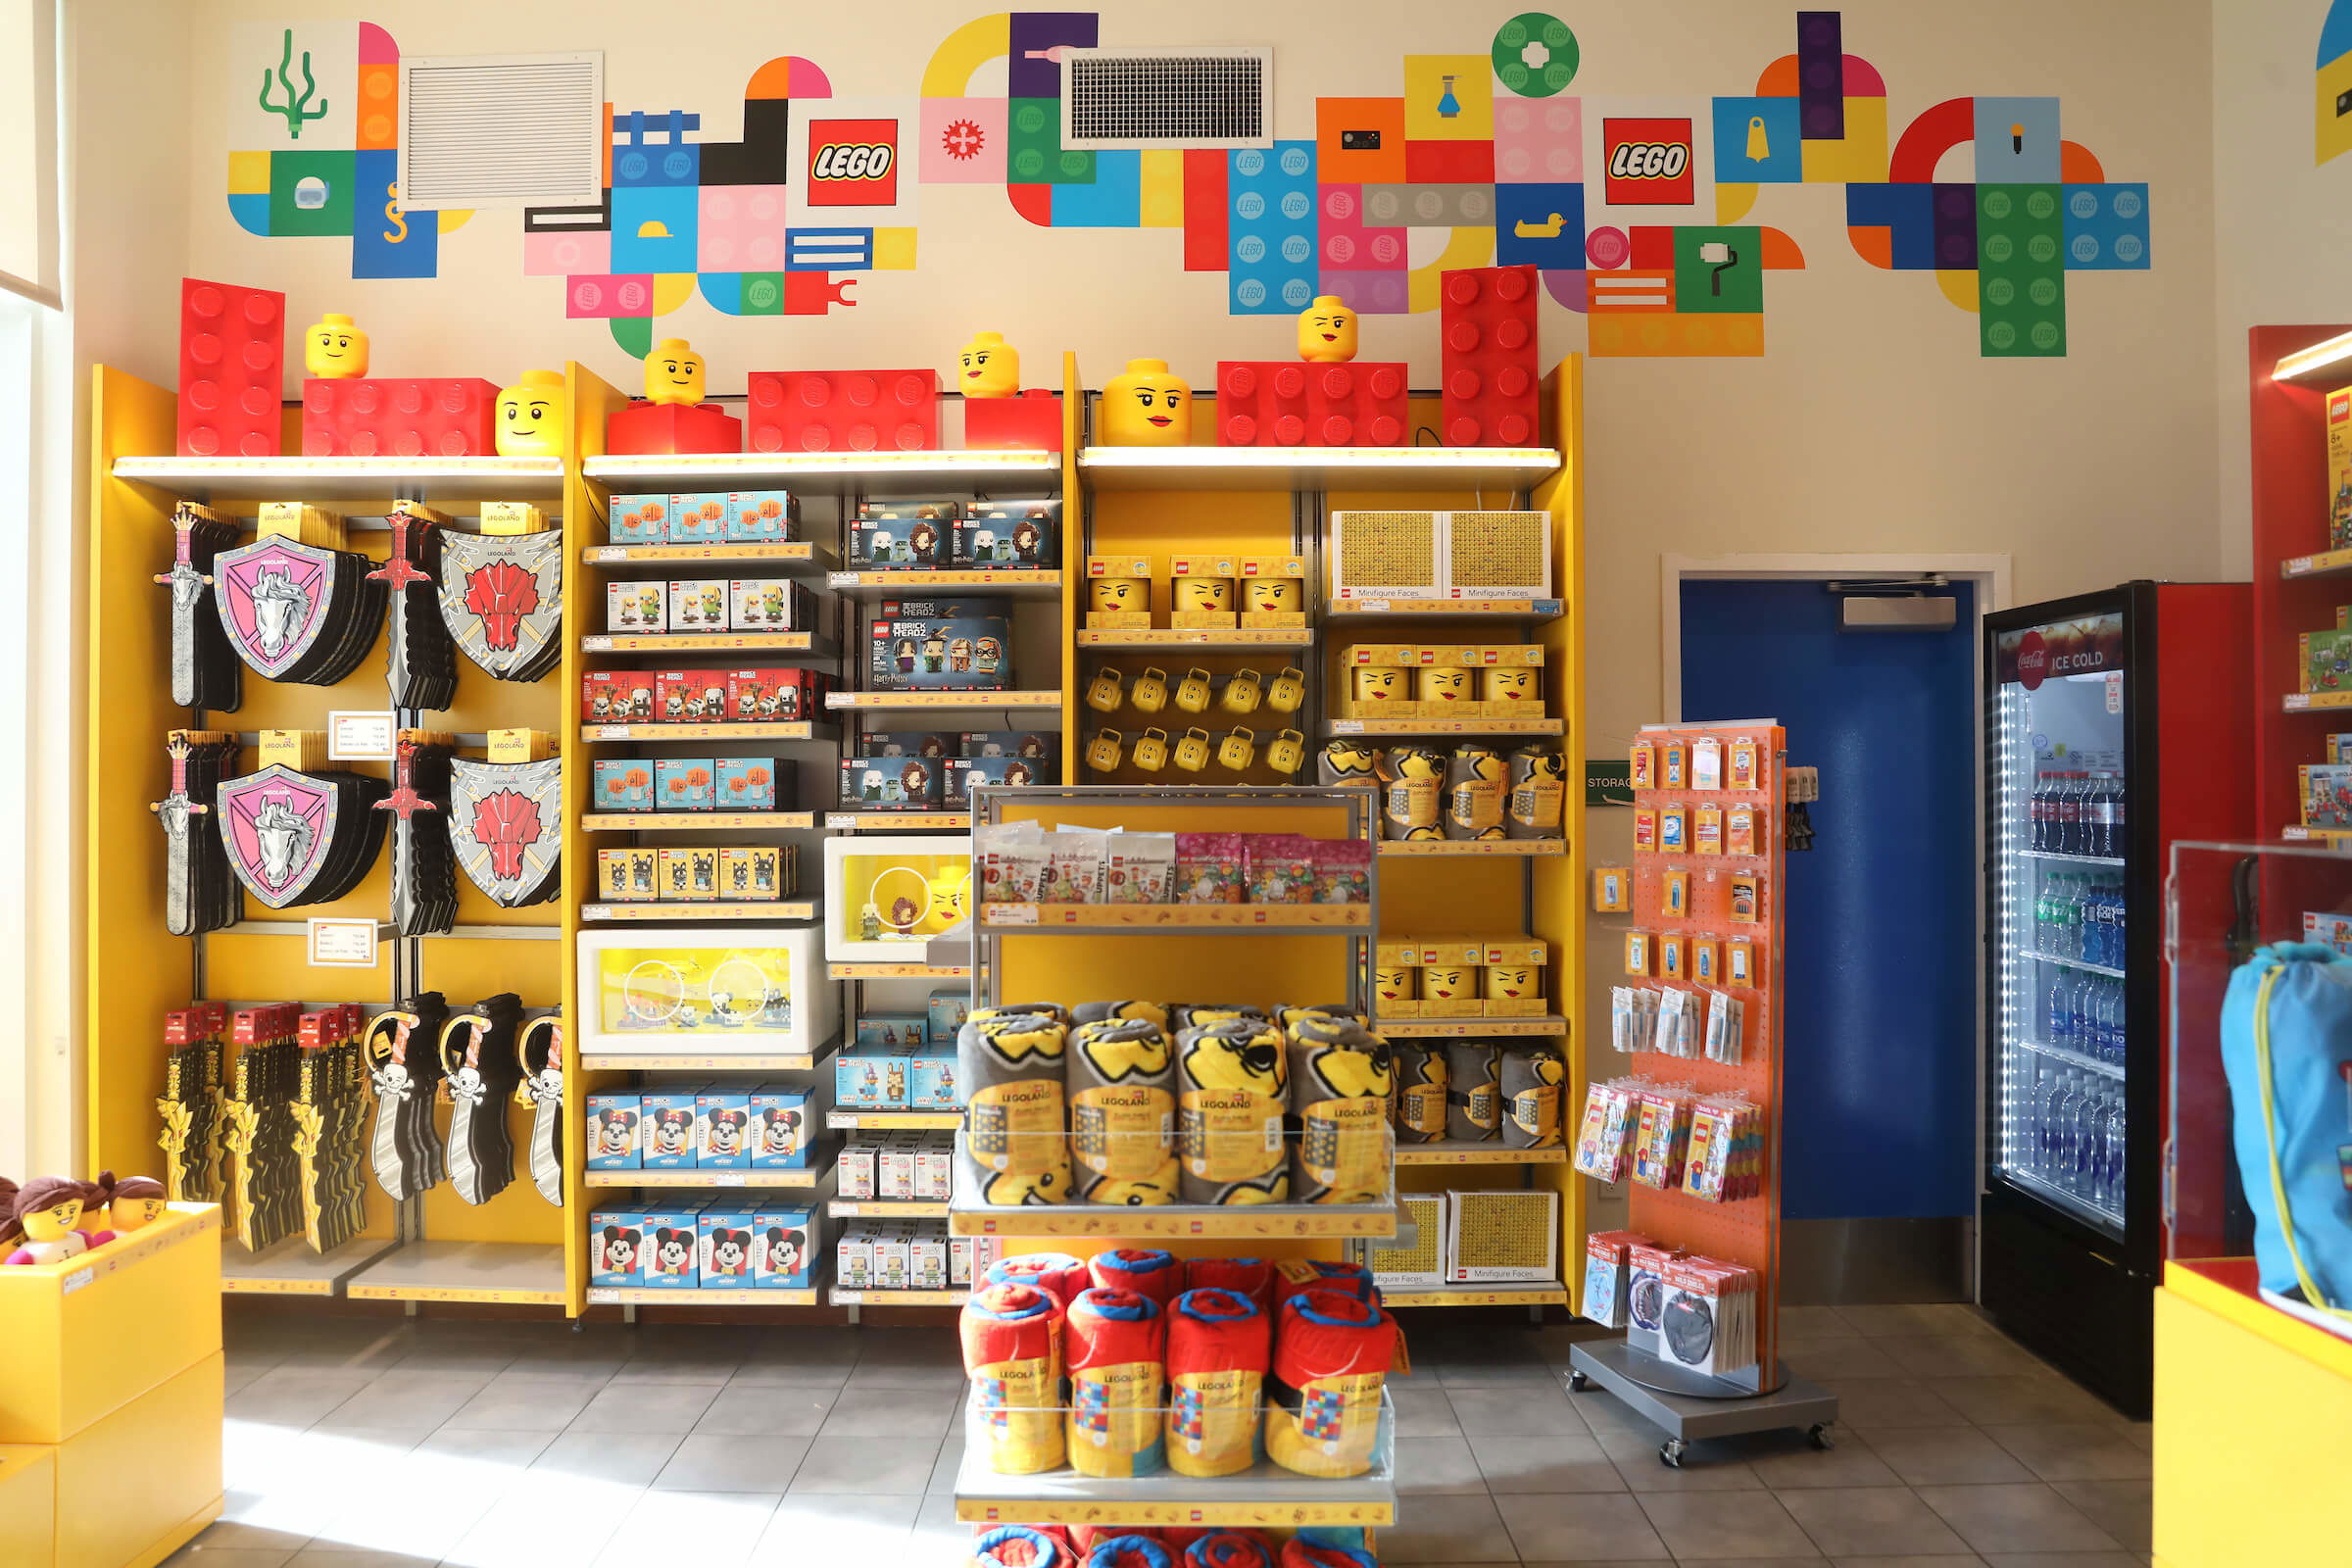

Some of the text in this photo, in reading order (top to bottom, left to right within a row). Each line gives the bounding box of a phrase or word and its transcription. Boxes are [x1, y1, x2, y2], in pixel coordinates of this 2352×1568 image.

[813, 145, 892, 178] LEGO
[1240, 156, 1261, 168] LEGO
[1284, 156, 1305, 168] LEGO
[1610, 144, 1688, 178] LEGO
[1240, 200, 1261, 211] LEGO
[1285, 199, 1306, 211] LEGO
[1333, 194, 1347, 217] LEGO
[2074, 199, 2094, 212] LEGO
[2117, 199, 2138, 212] LEGO
[1241, 243, 1261, 255] LEGO
[1285, 243, 1307, 255] LEGO
[1334, 237, 1347, 260] LEGO
[1380, 237, 1391, 260] LEGO
[1595, 242, 1619, 255] LEGO
[2075, 242, 2096, 254] LEGO
[2118, 242, 2139, 254] LEGO
[752, 288, 773, 300] LEGO
[1241, 286, 1262, 298] LEGO
[1286, 286, 1307, 298] LEGO
[1358, 589, 1396, 598] Minifigure
[1469, 589, 1505, 598] Minifigure
[2052, 652, 2103, 670] ICE COLD
[1588, 777, 1631, 788] STORAG
[1096, 860, 1105, 894] UPPETS
[1036, 866, 1049, 902] UPPETS
[1162, 866, 1174, 903] UPPETS
[1003, 1092, 1051, 1102] LEGOLAND
[1102, 1096, 1151, 1106] LEGOLAND
[1200, 1099, 1250, 1109] LEGOLAND
[1335, 1107, 1377, 1117] LEGOLAND
[1475, 1270, 1510, 1279] Minifigure
[1000, 1367, 1046, 1380] LEGOLAD
[1198, 1380, 1245, 1391] LEGOLAD
